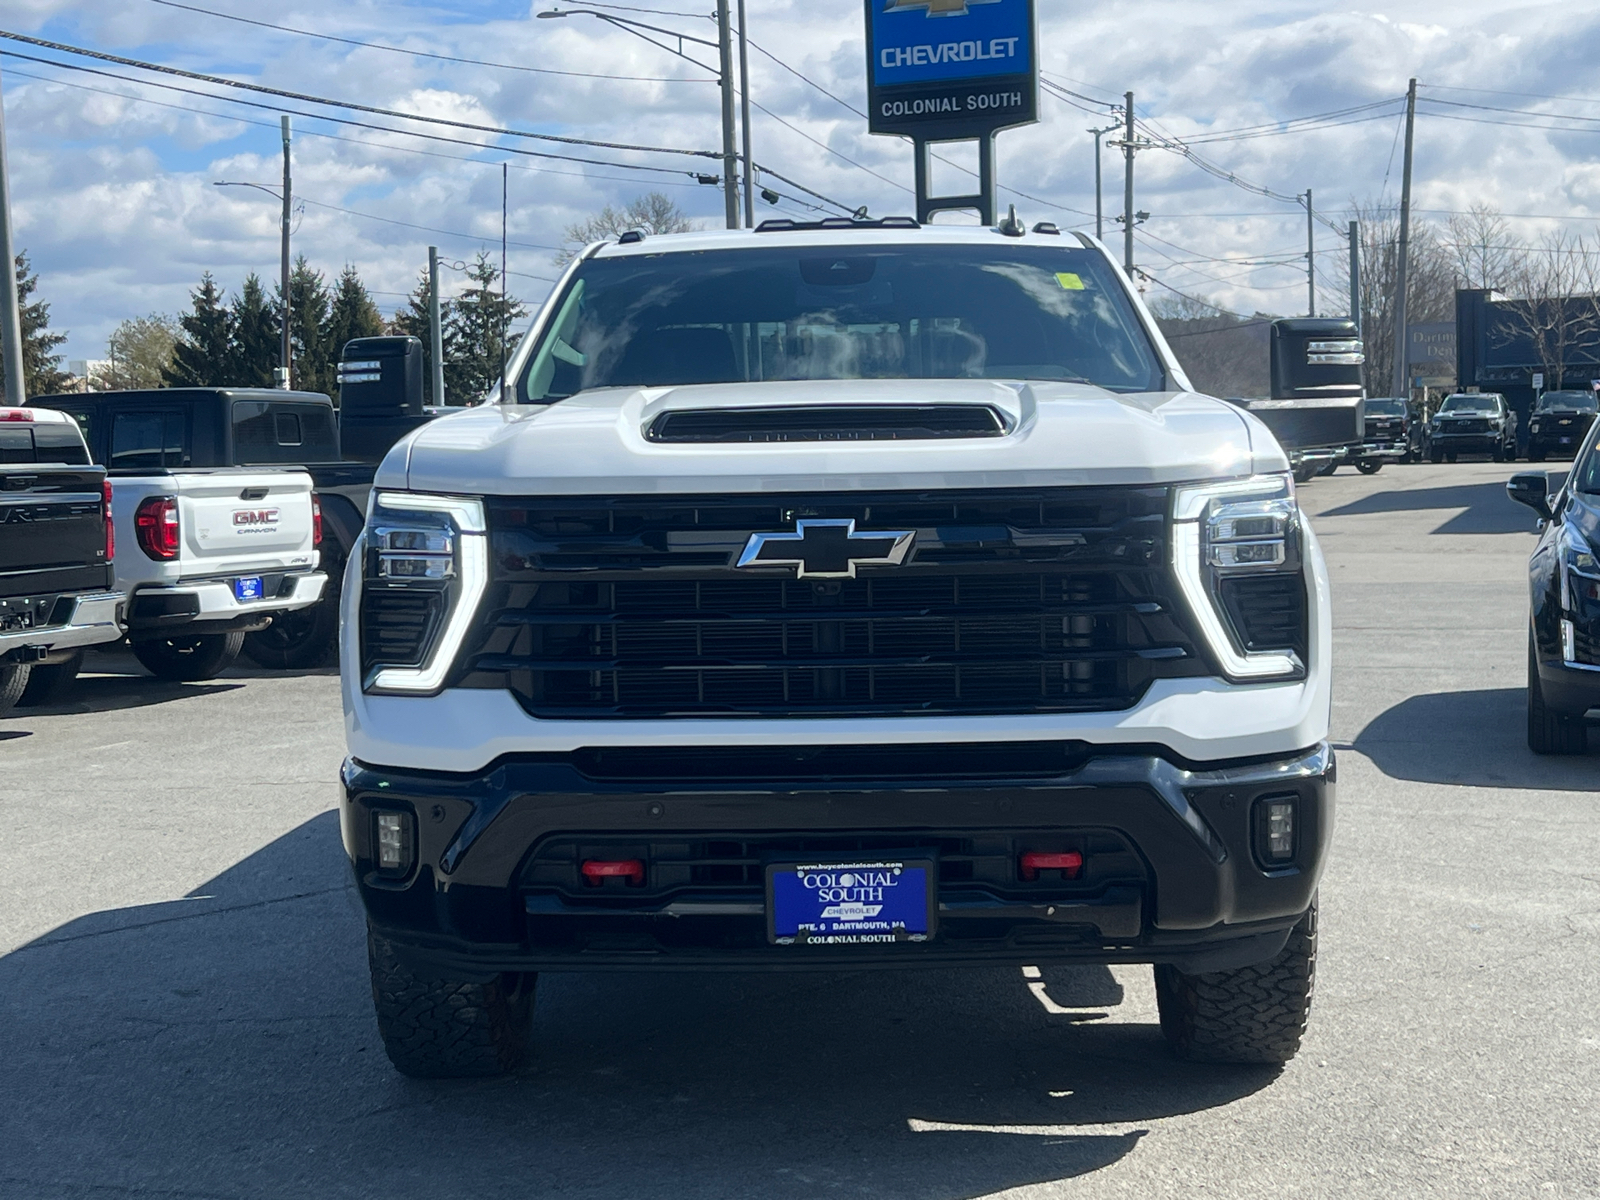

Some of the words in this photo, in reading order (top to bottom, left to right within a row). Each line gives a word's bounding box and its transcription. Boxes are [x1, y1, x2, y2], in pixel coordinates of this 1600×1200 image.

[880, 37, 1019, 68] CHEVROLET
[881, 97, 962, 117] COLONIAL
[966, 92, 1022, 110] SOUTH
[233, 510, 279, 526] GMC
[237, 527, 277, 535] CANYON
[96, 549, 105, 557] LT
[796, 862, 903, 871] www.buycolonialsouth.com
[803, 872, 898, 889] COLONIAL
[818, 887, 883, 903] SOUTH
[827, 907, 876, 915] CHEVROLET
[832, 921, 890, 931] DARTMOUTH,
[807, 935, 860, 944] COLONIAL
[860, 934, 896, 943] SOUTH
